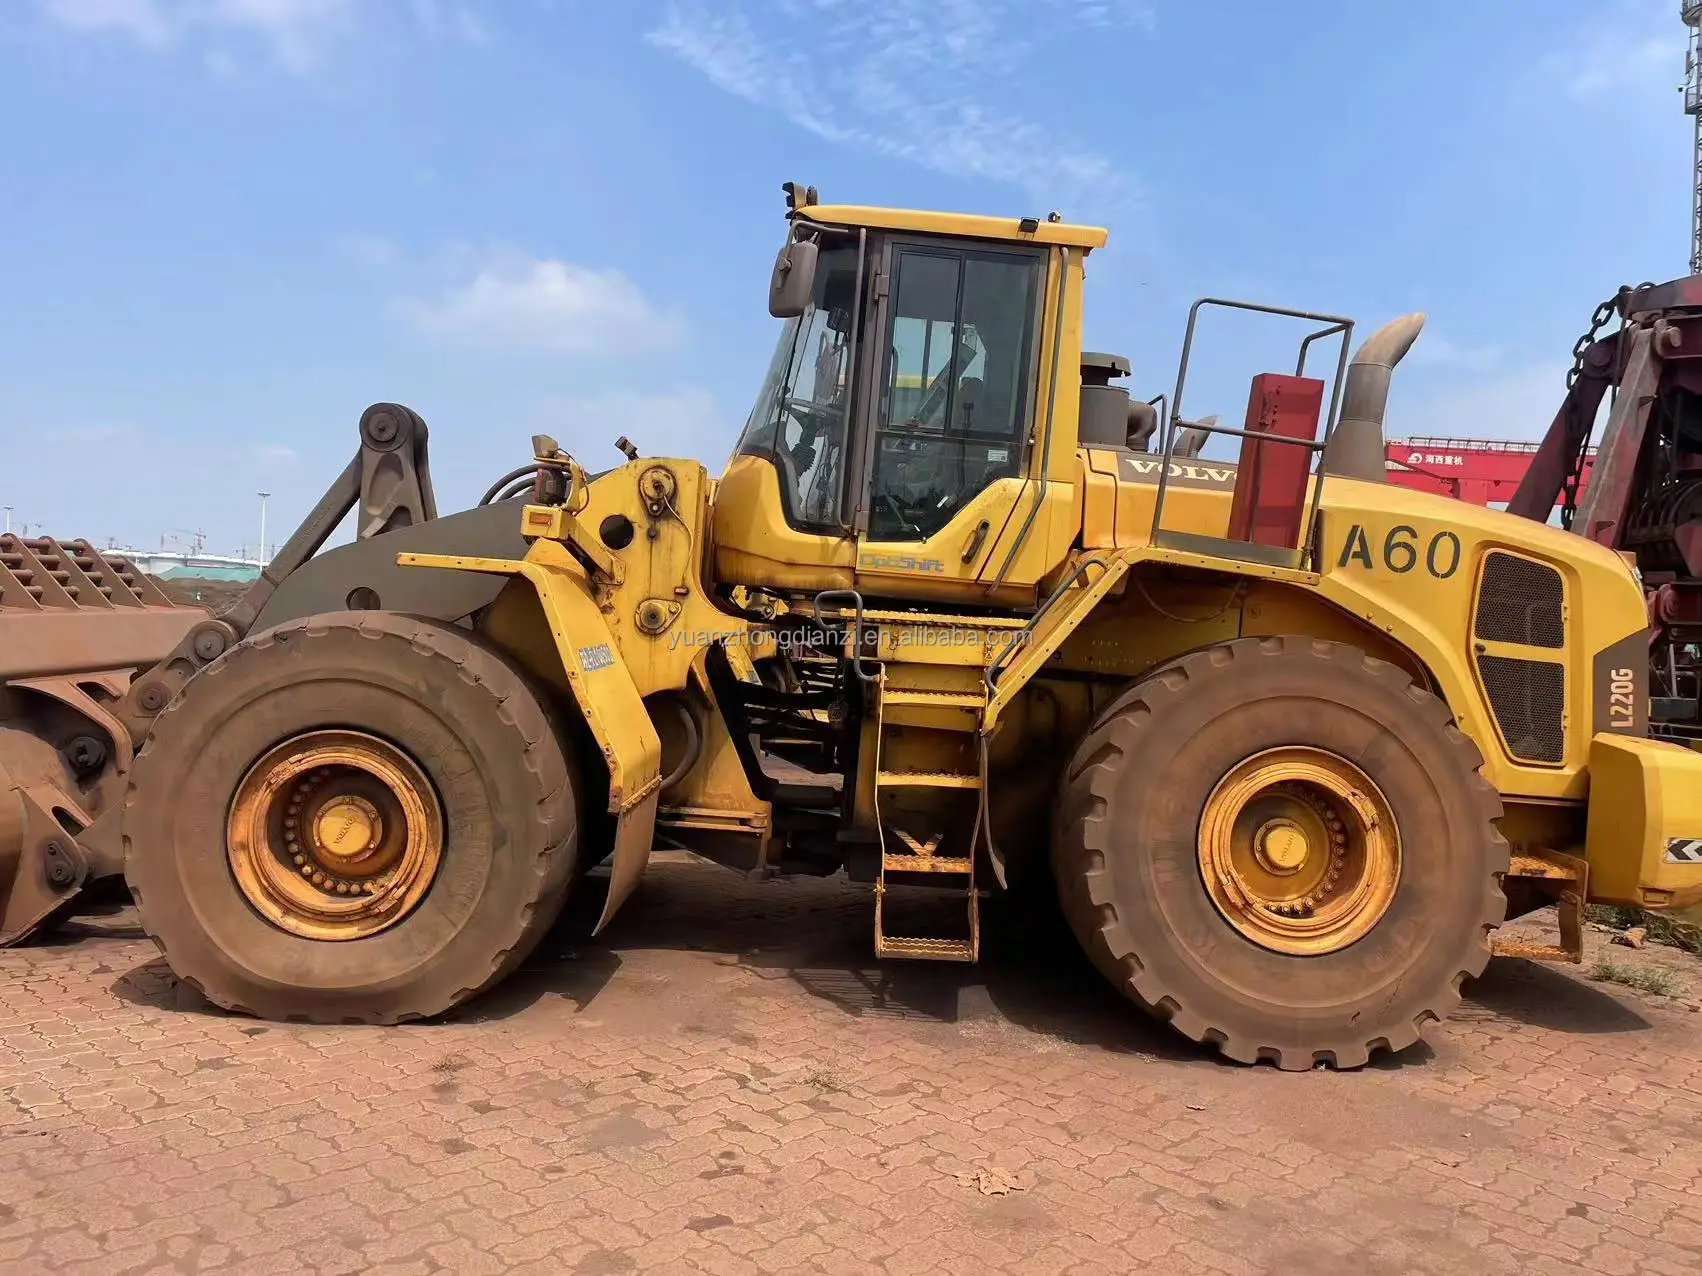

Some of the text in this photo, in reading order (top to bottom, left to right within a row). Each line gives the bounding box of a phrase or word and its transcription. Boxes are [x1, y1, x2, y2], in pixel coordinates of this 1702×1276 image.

[1125, 459, 1238, 482] VOLV
[1425, 454, 1464, 466] 海西重机
[1337, 524, 1461, 579] A60
[1610, 668, 1634, 728] L220G
